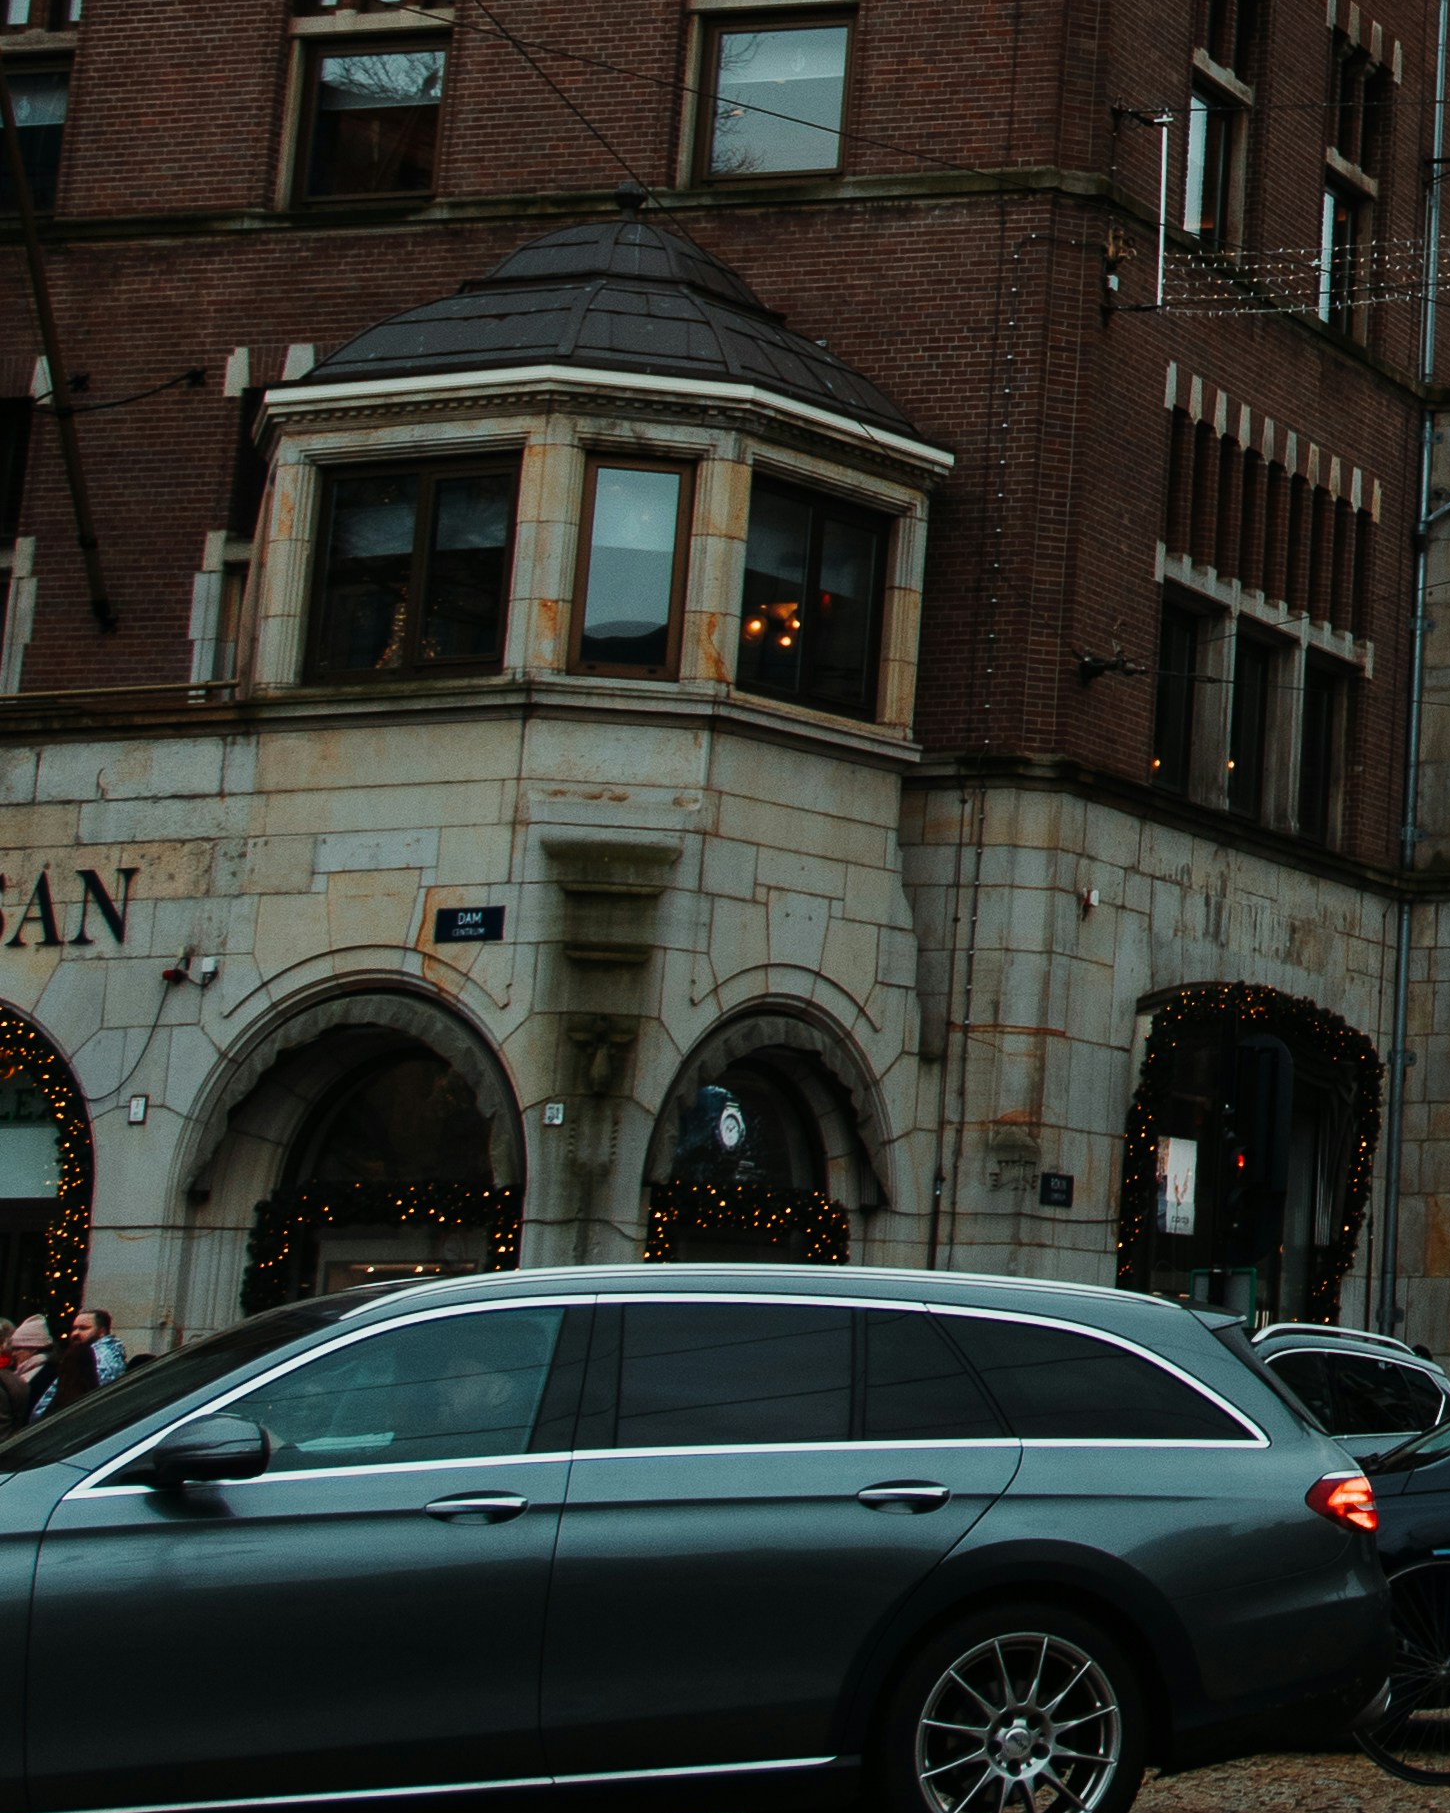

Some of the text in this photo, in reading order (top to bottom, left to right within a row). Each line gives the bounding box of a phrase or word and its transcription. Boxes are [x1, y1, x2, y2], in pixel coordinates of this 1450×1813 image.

[0, 867, 140, 947] AN
[457, 912, 482, 925] DAM
[452, 927, 486, 937] CENTRUM
